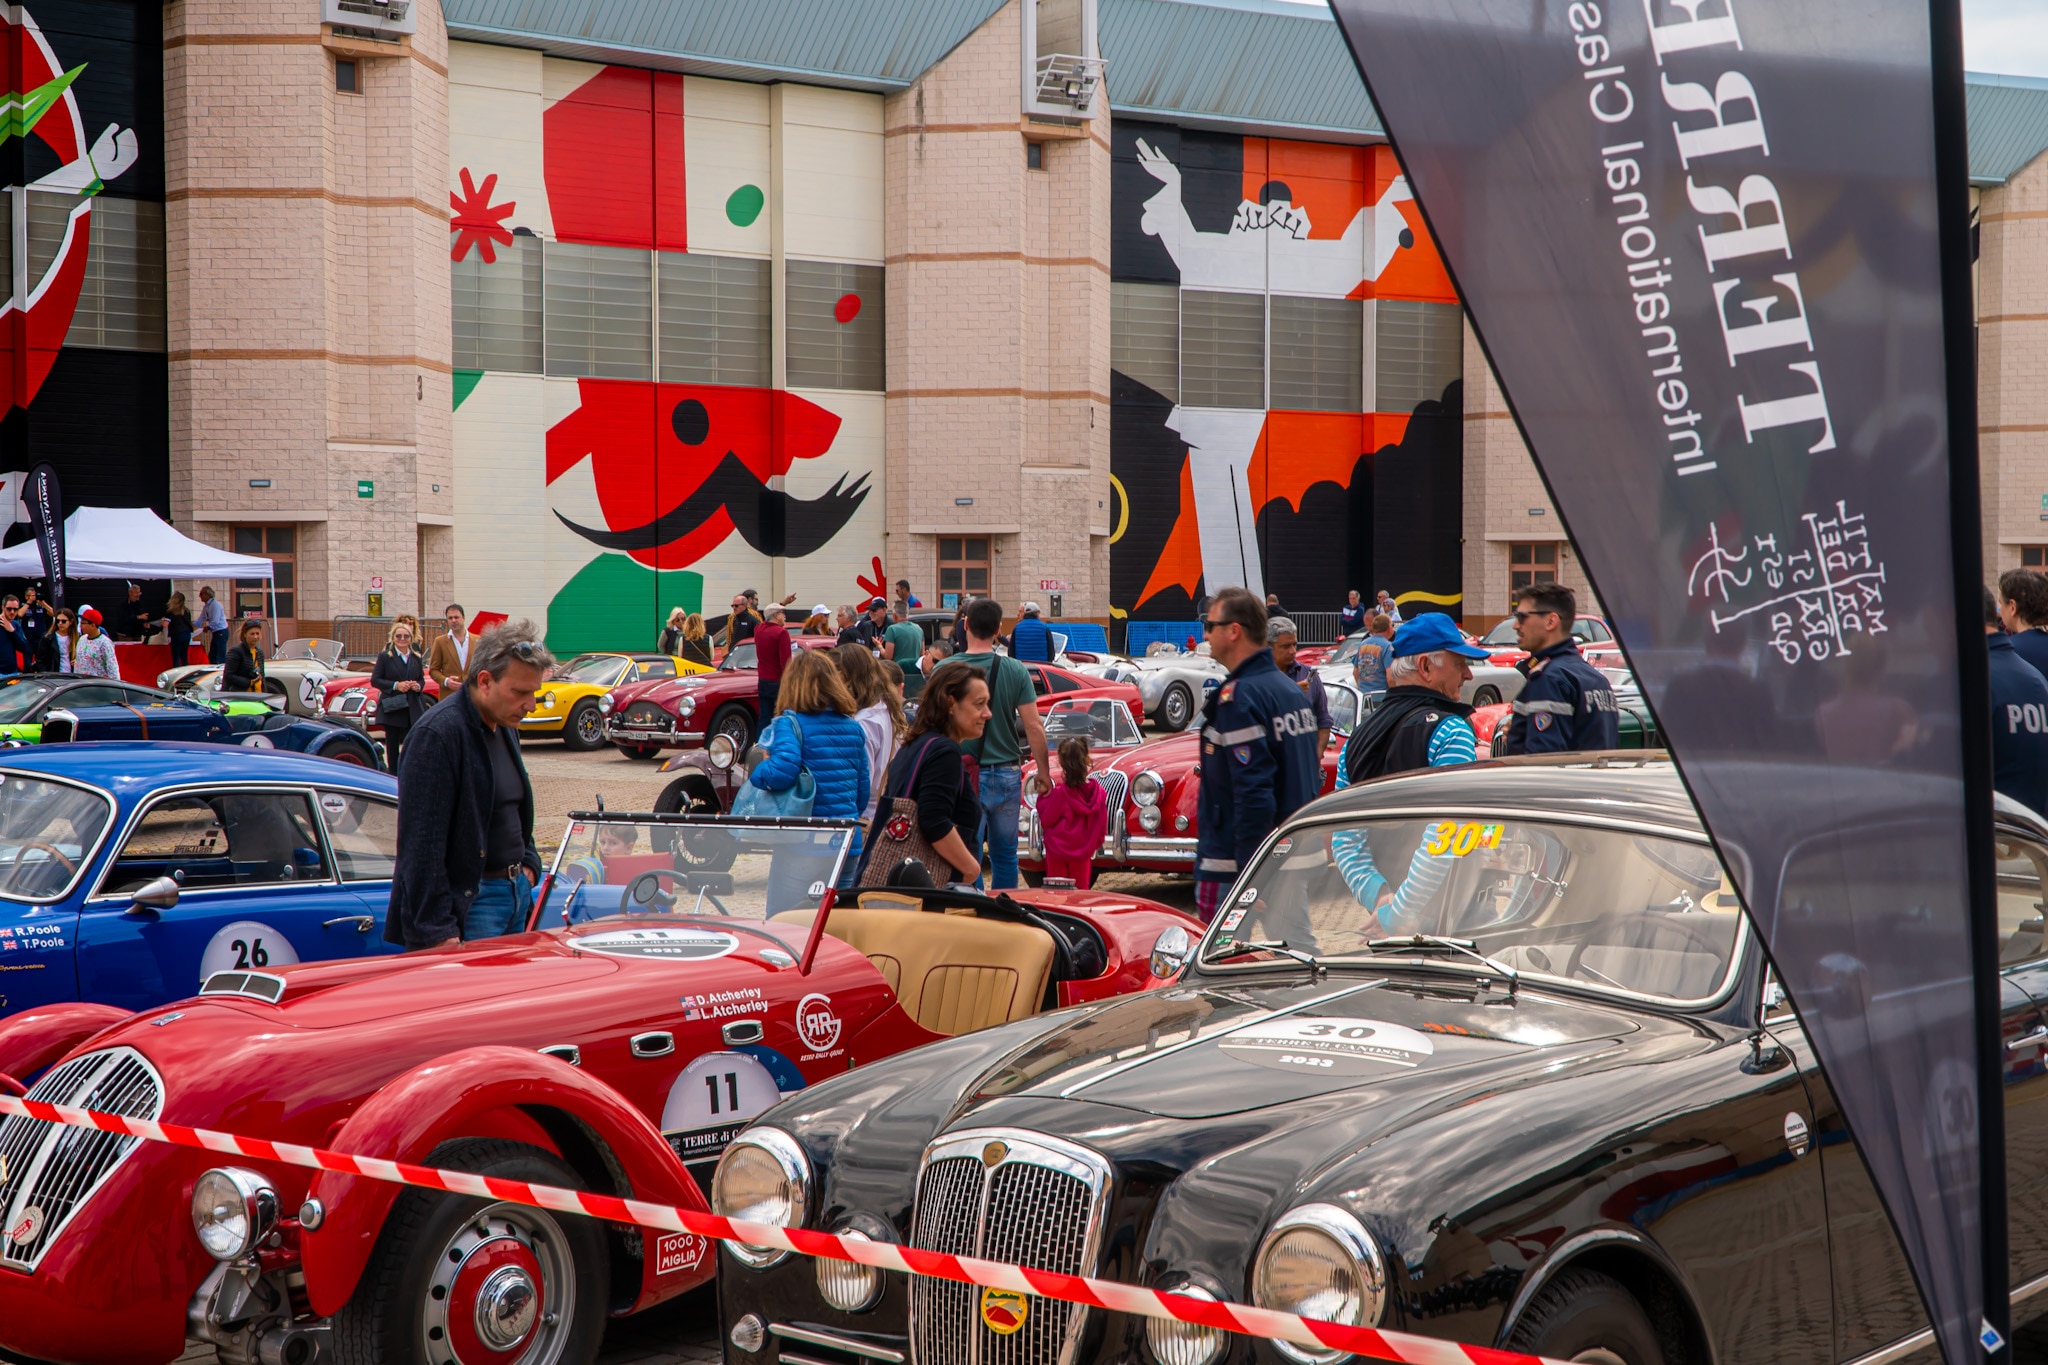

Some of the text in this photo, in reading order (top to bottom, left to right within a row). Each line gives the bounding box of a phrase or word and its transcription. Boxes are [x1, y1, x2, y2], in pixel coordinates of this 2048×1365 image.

[1426, 820, 1482, 857] 30
[813, 884, 822, 893] 11
[1242, 891, 1255, 901] 30
[14, 924, 61, 937] R.Poole
[21, 937, 65, 950] T.Poole
[231, 938, 269, 970] 26
[695, 987, 762, 1006] D.Atcherley
[700, 999, 769, 1020] L.Atcherley
[1298, 1024, 1377, 1040] 30
[1278, 1054, 1335, 1068] 2023
[705, 1072, 739, 1115] 11
[683, 1132, 719, 1149] TERRE
[720, 1130, 730, 1142] di
[664, 1234, 694, 1253] 1000
[661, 1249, 696, 1269] MIGLIA
